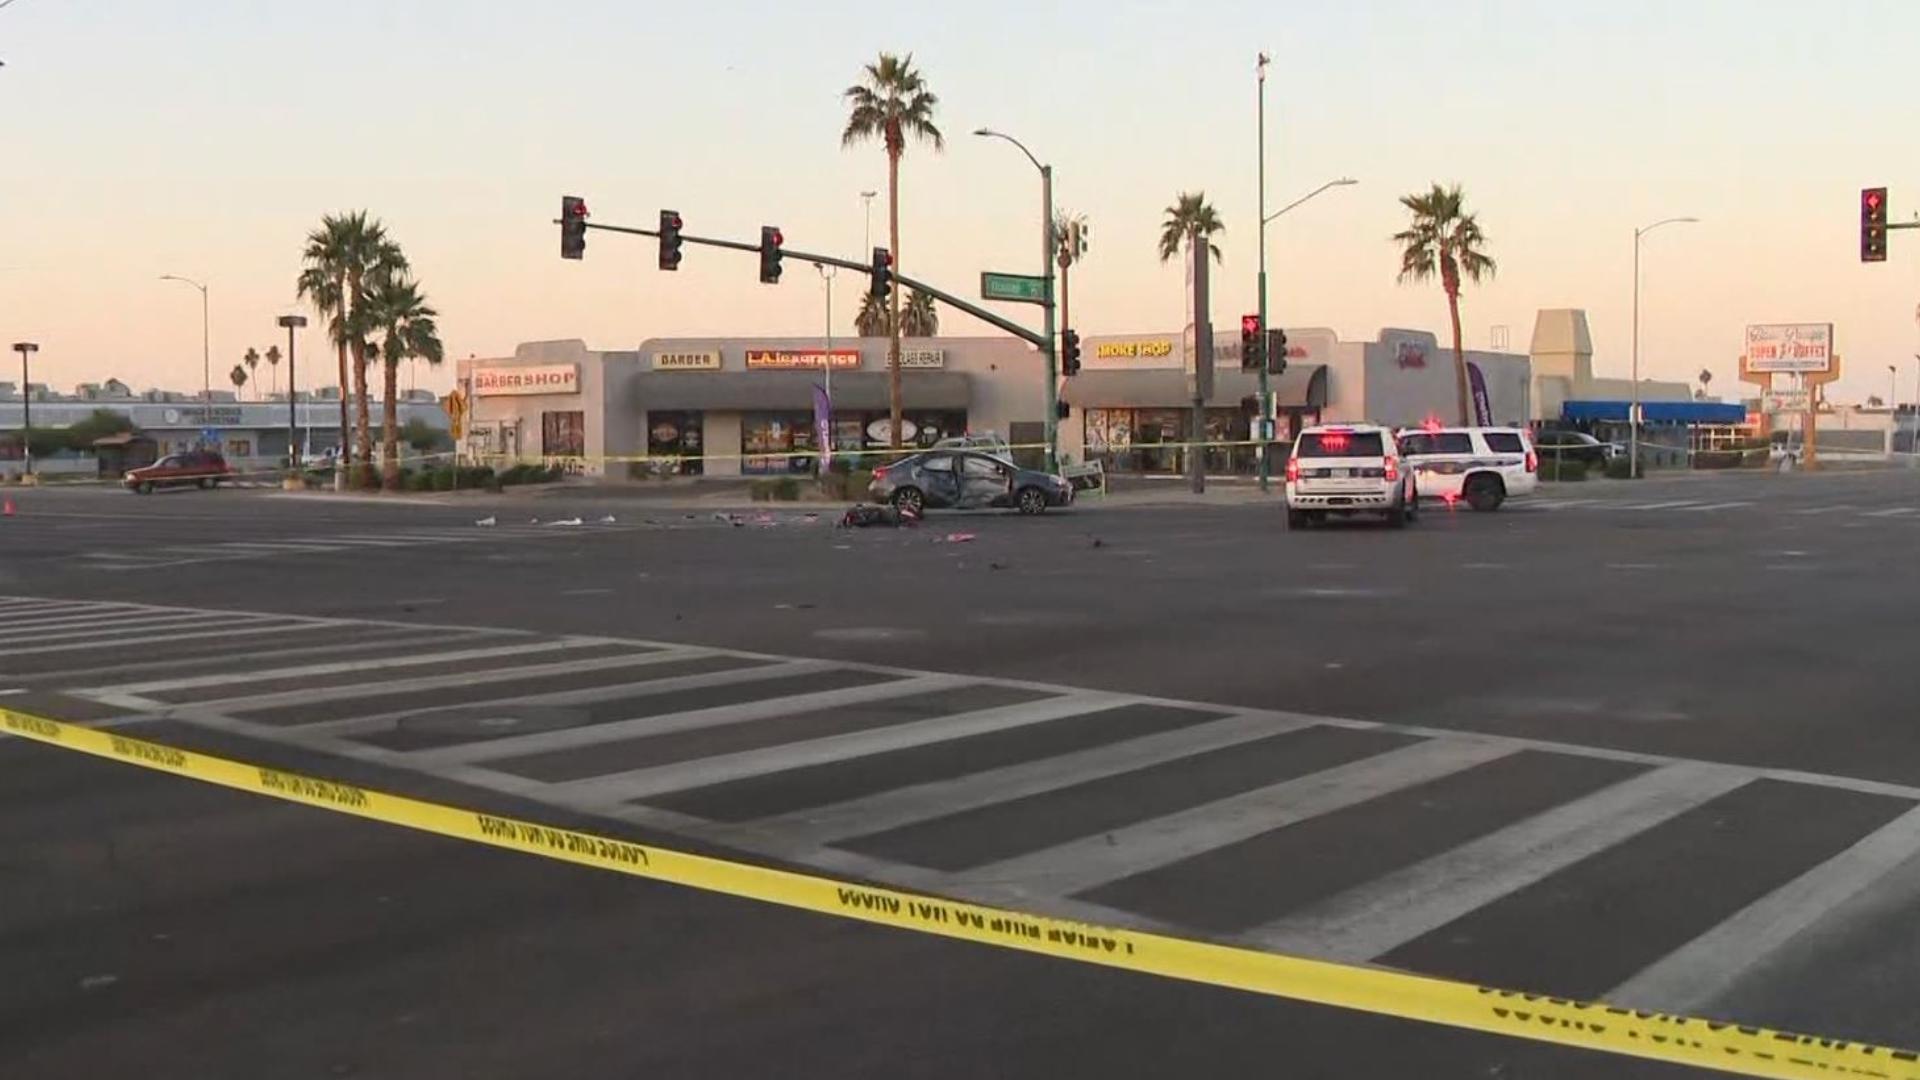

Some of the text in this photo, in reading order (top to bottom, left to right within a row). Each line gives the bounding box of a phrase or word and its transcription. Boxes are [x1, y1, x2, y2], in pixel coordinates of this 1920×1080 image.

[661, 354, 711, 365] BARBER
[475, 372, 575, 388] BARBER SHOP
